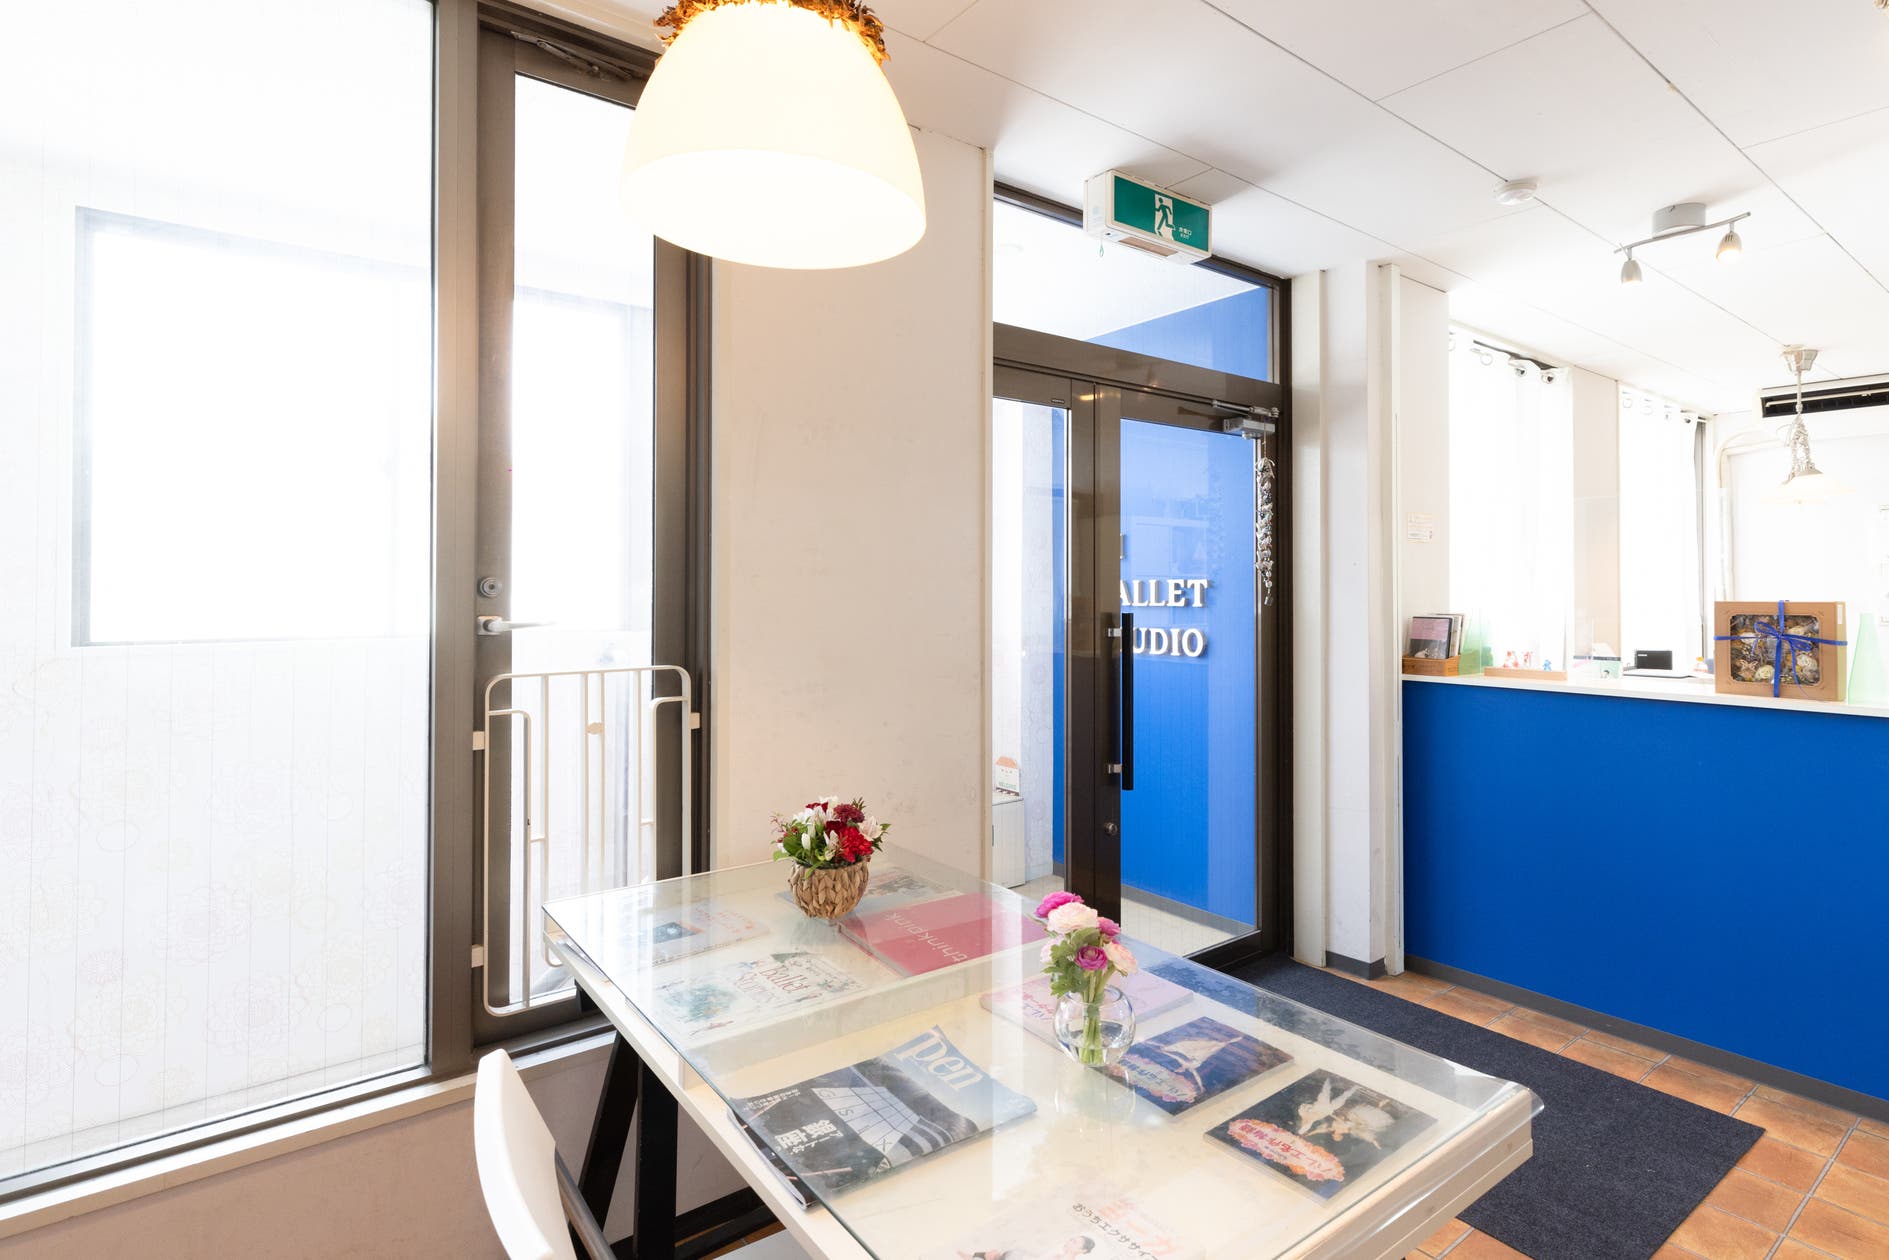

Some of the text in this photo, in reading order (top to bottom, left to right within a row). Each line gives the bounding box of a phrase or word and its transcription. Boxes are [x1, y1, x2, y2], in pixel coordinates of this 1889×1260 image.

[1120, 579, 1208, 607] ALLET
[1130, 626, 1204, 657] UDIO
[760, 965, 810, 994] Ballet
[1073, 1203, 1158, 1260] おうちエクササイ
